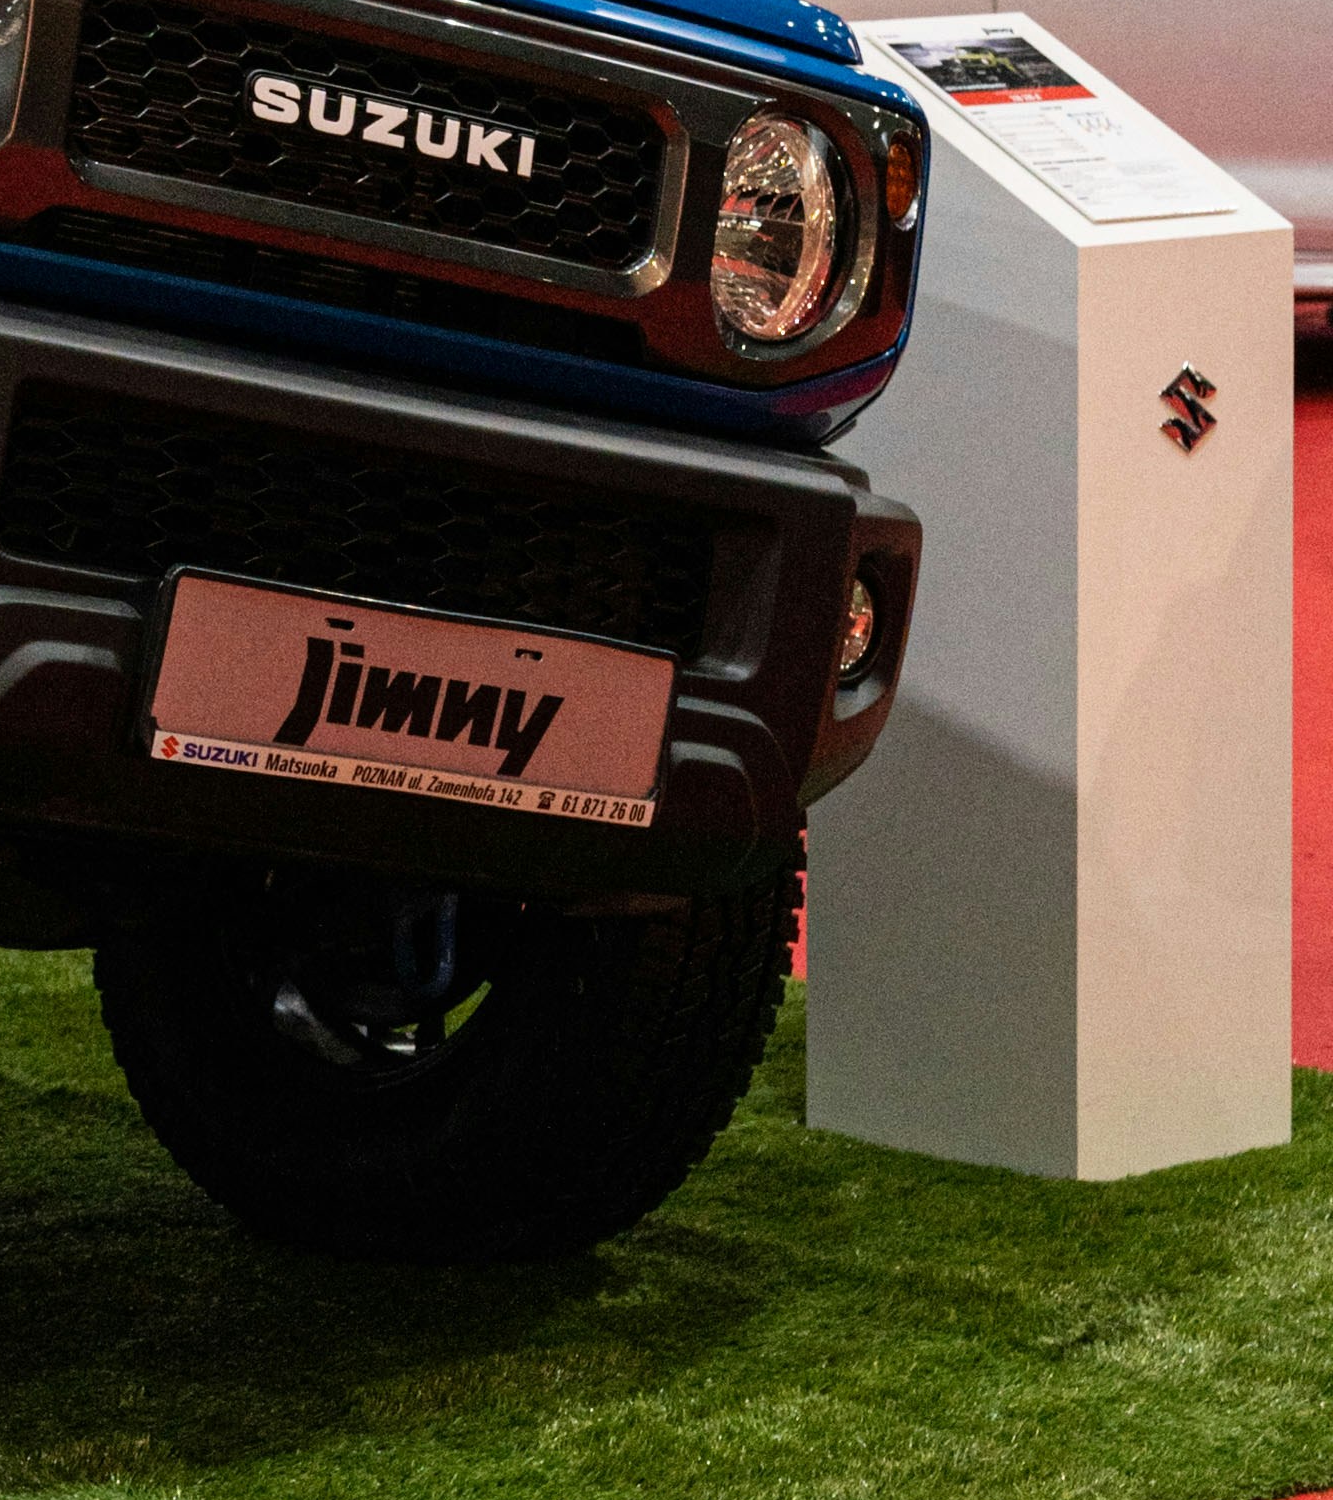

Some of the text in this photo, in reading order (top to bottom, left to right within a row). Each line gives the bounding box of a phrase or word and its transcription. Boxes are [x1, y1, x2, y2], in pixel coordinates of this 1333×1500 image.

[251, 75, 536, 178] SUZUKI
[182, 742, 259, 767] SUZUKI
[265, 753, 338, 779] Matsuoka
[408, 773, 423, 791] ul.
[426, 775, 496, 802] Zamenhofa
[498, 788, 523, 806] 142
[561, 794, 579, 814] 61
[580, 797, 605, 817] 871
[610, 801, 627, 820] 26
[628, 804, 646, 823] 00
